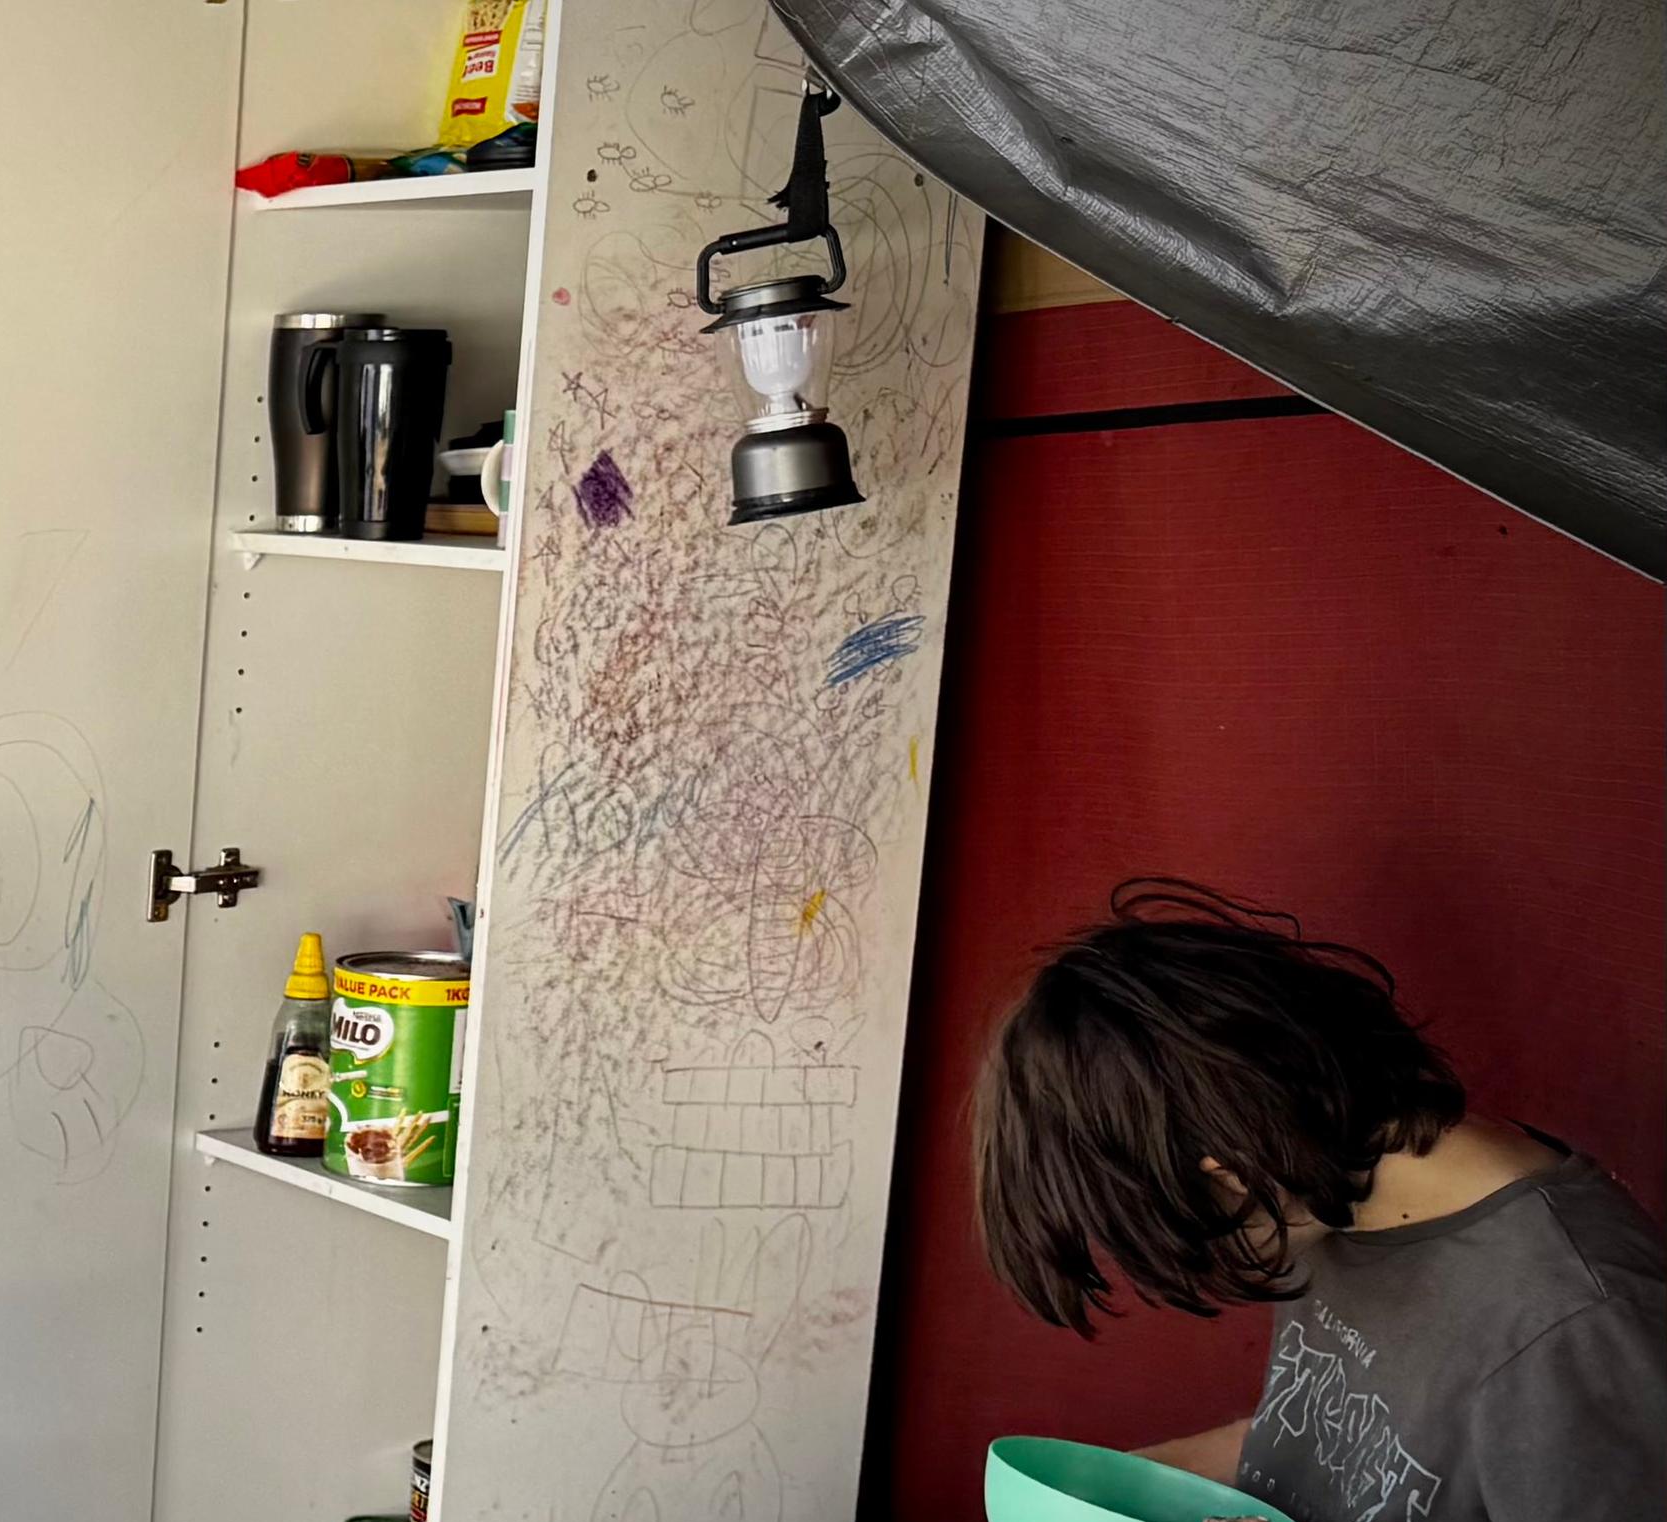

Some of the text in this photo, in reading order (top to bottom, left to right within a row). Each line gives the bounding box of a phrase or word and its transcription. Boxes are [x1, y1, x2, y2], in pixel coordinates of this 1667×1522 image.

[369, 983, 411, 1000] PACK
[332, 1013, 381, 1046] MILO
[282, 1089, 325, 1099] HONEY
